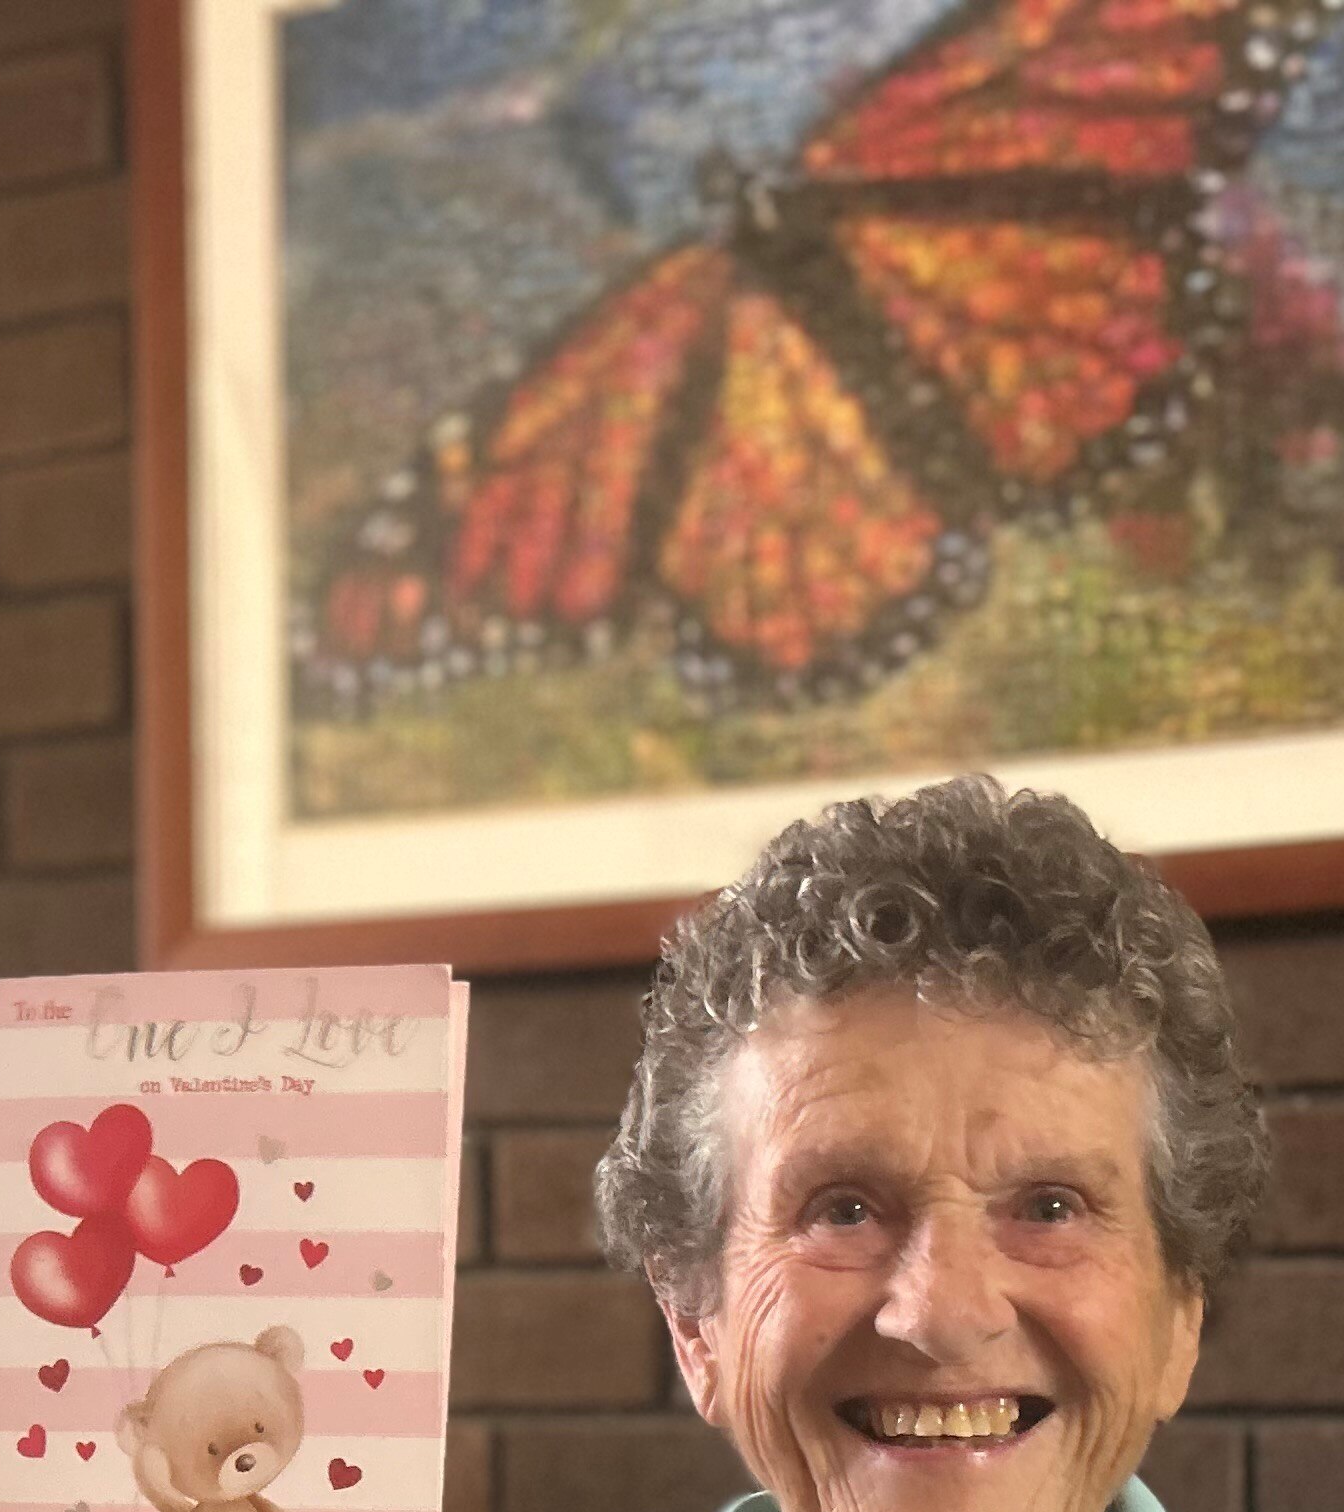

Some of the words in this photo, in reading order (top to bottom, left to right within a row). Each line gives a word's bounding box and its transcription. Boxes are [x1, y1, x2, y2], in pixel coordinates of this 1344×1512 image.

[14, 1001, 36, 1021] To
[44, 1000, 72, 1021] the
[280, 976, 414, 1068] Love
[139, 1079, 161, 1094] on
[170, 1075, 272, 1094] Valentine's
[281, 1075, 315, 1096] Day
